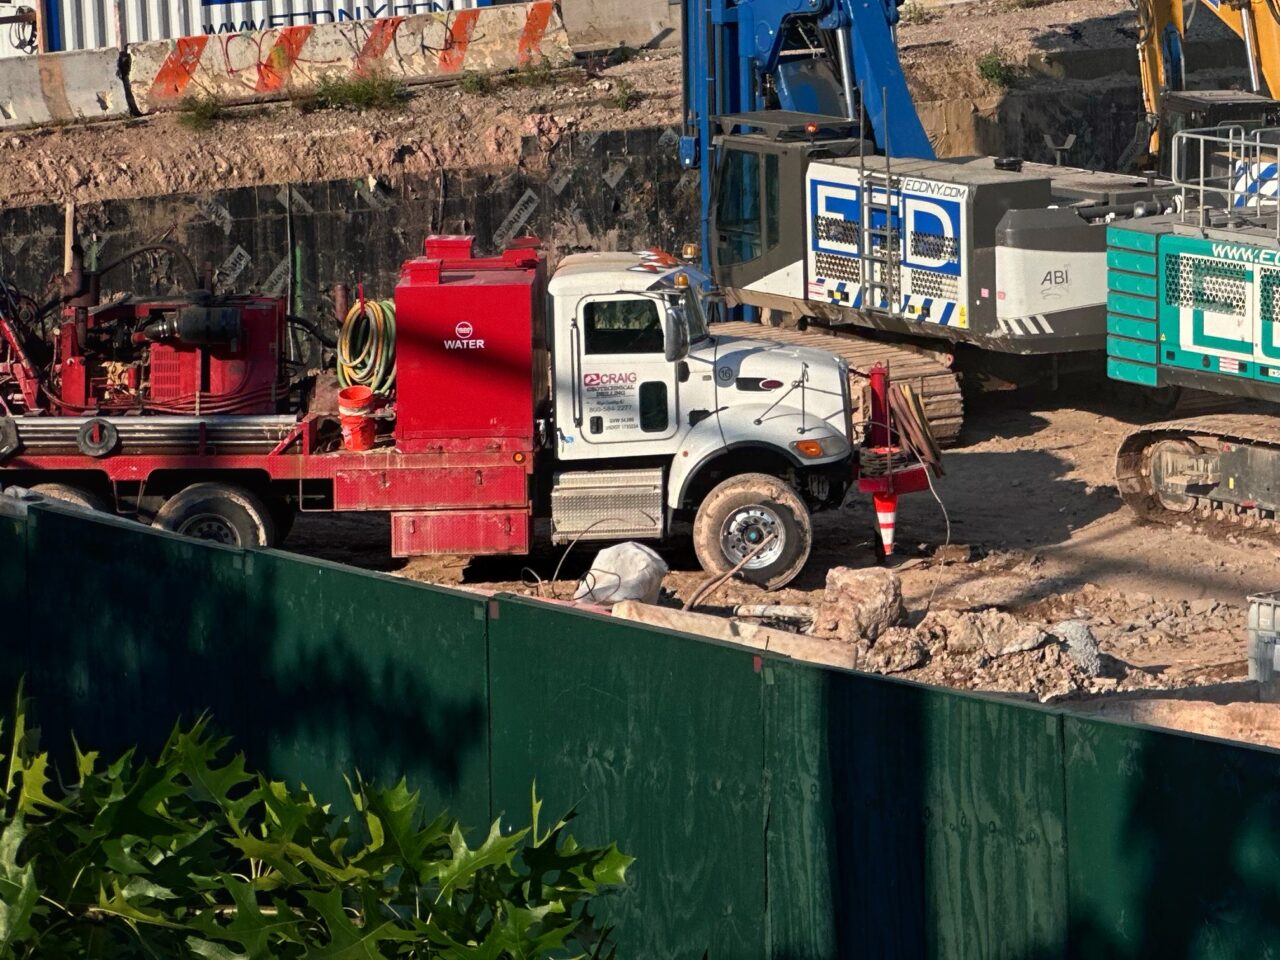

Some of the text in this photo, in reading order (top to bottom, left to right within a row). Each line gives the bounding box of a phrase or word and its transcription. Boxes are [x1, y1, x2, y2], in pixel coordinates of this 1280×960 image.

[904, 179, 966, 199] ECDNY.COM
[1041, 270, 1069, 285] ABI
[443, 339, 485, 350] WATER
[600, 372, 637, 385] CRAIG
